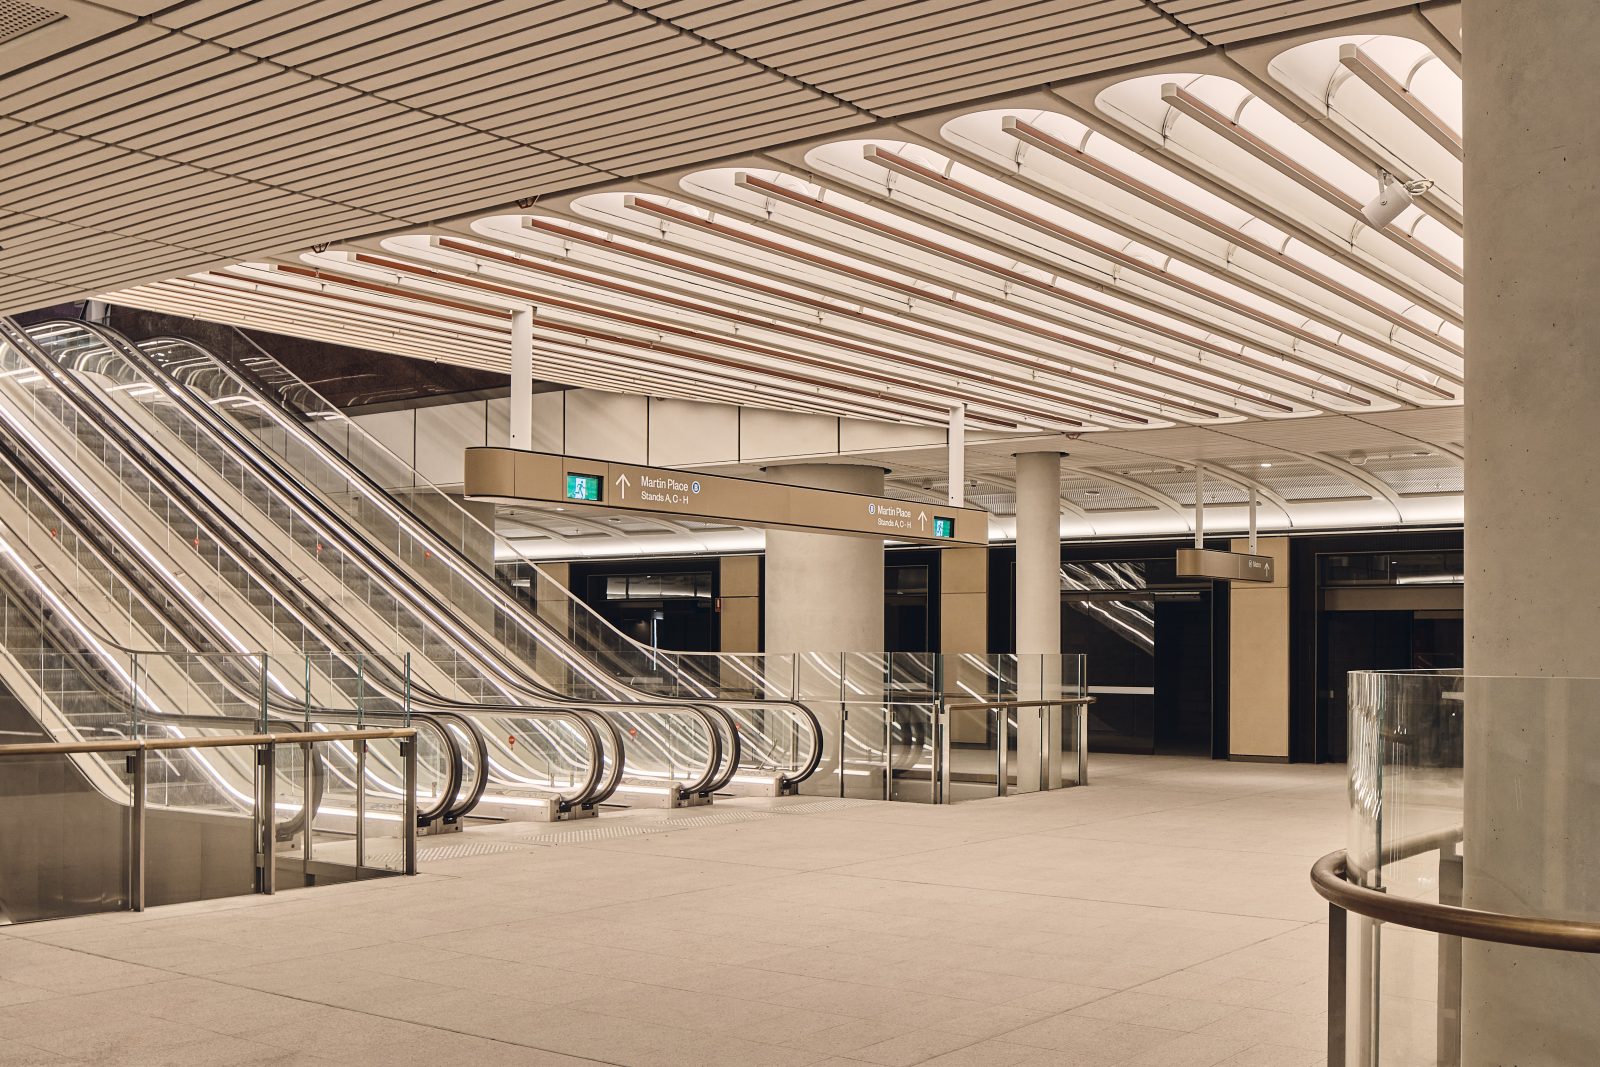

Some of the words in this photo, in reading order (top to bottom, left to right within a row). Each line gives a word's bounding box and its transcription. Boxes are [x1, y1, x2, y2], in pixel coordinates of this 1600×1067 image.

[641, 476, 666, 488] Martin
[668, 478, 688, 492] Place
[641, 490, 664, 502] Stands
[878, 505, 896, 516] Martin
[896, 507, 911, 518] Place
